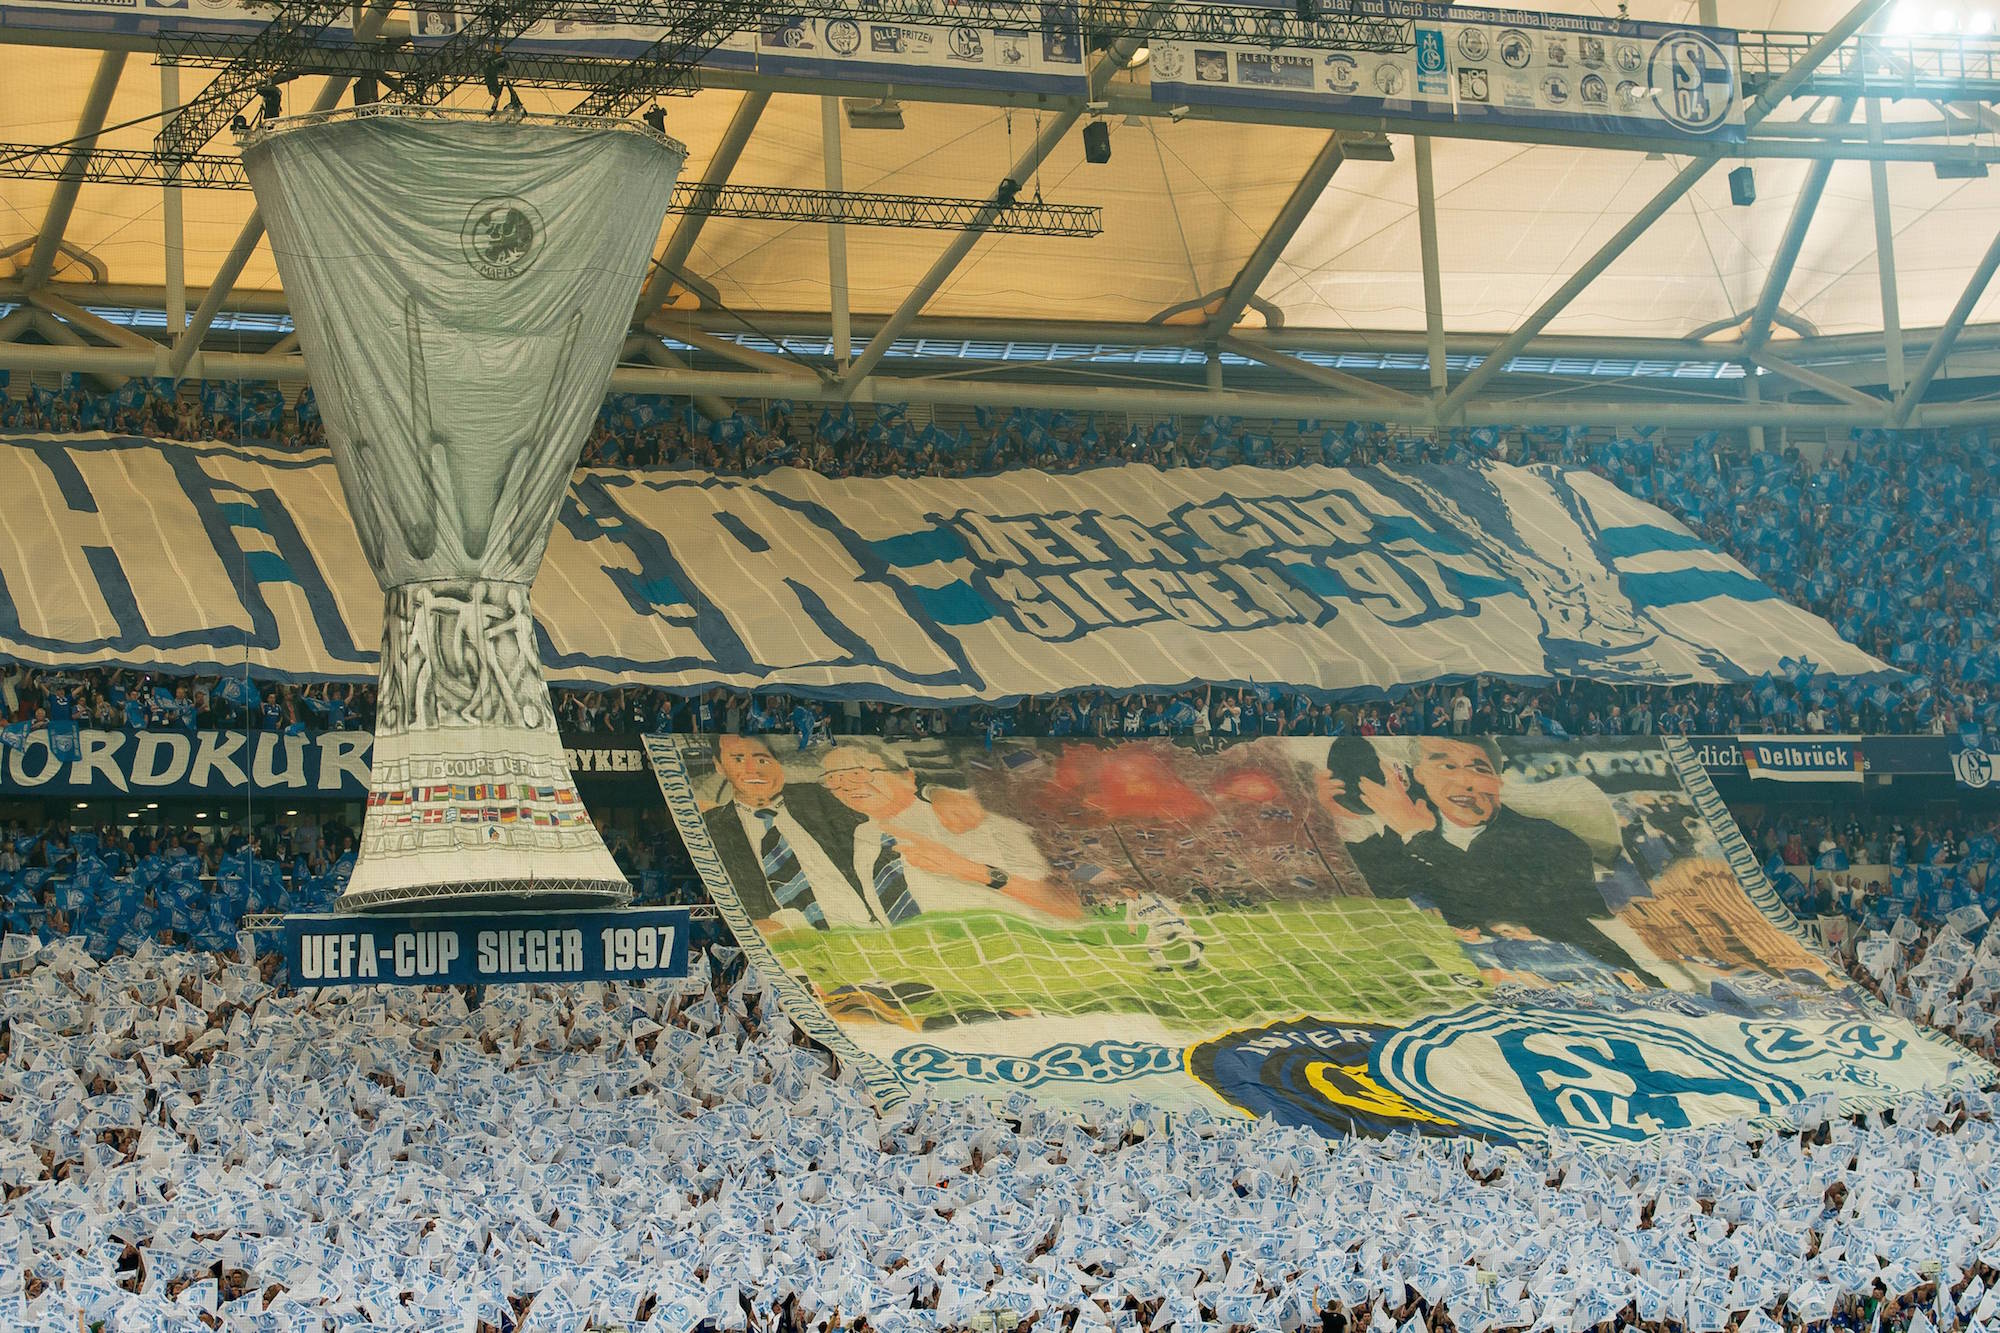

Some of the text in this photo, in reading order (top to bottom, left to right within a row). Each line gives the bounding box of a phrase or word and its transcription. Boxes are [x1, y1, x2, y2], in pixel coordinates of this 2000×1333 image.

[1388, 1, 1423, 17] Weiß
[1427, 4, 1445, 19] ist
[1448, 7, 1496, 21] unsere
[874, 29, 897, 41] OLLE
[1238, 53, 1312, 66] FLENSBURG
[1758, 744, 1850, 768] Delbrück
[301, 926, 675, 979] UEFA-CUP SIEGER 1997
